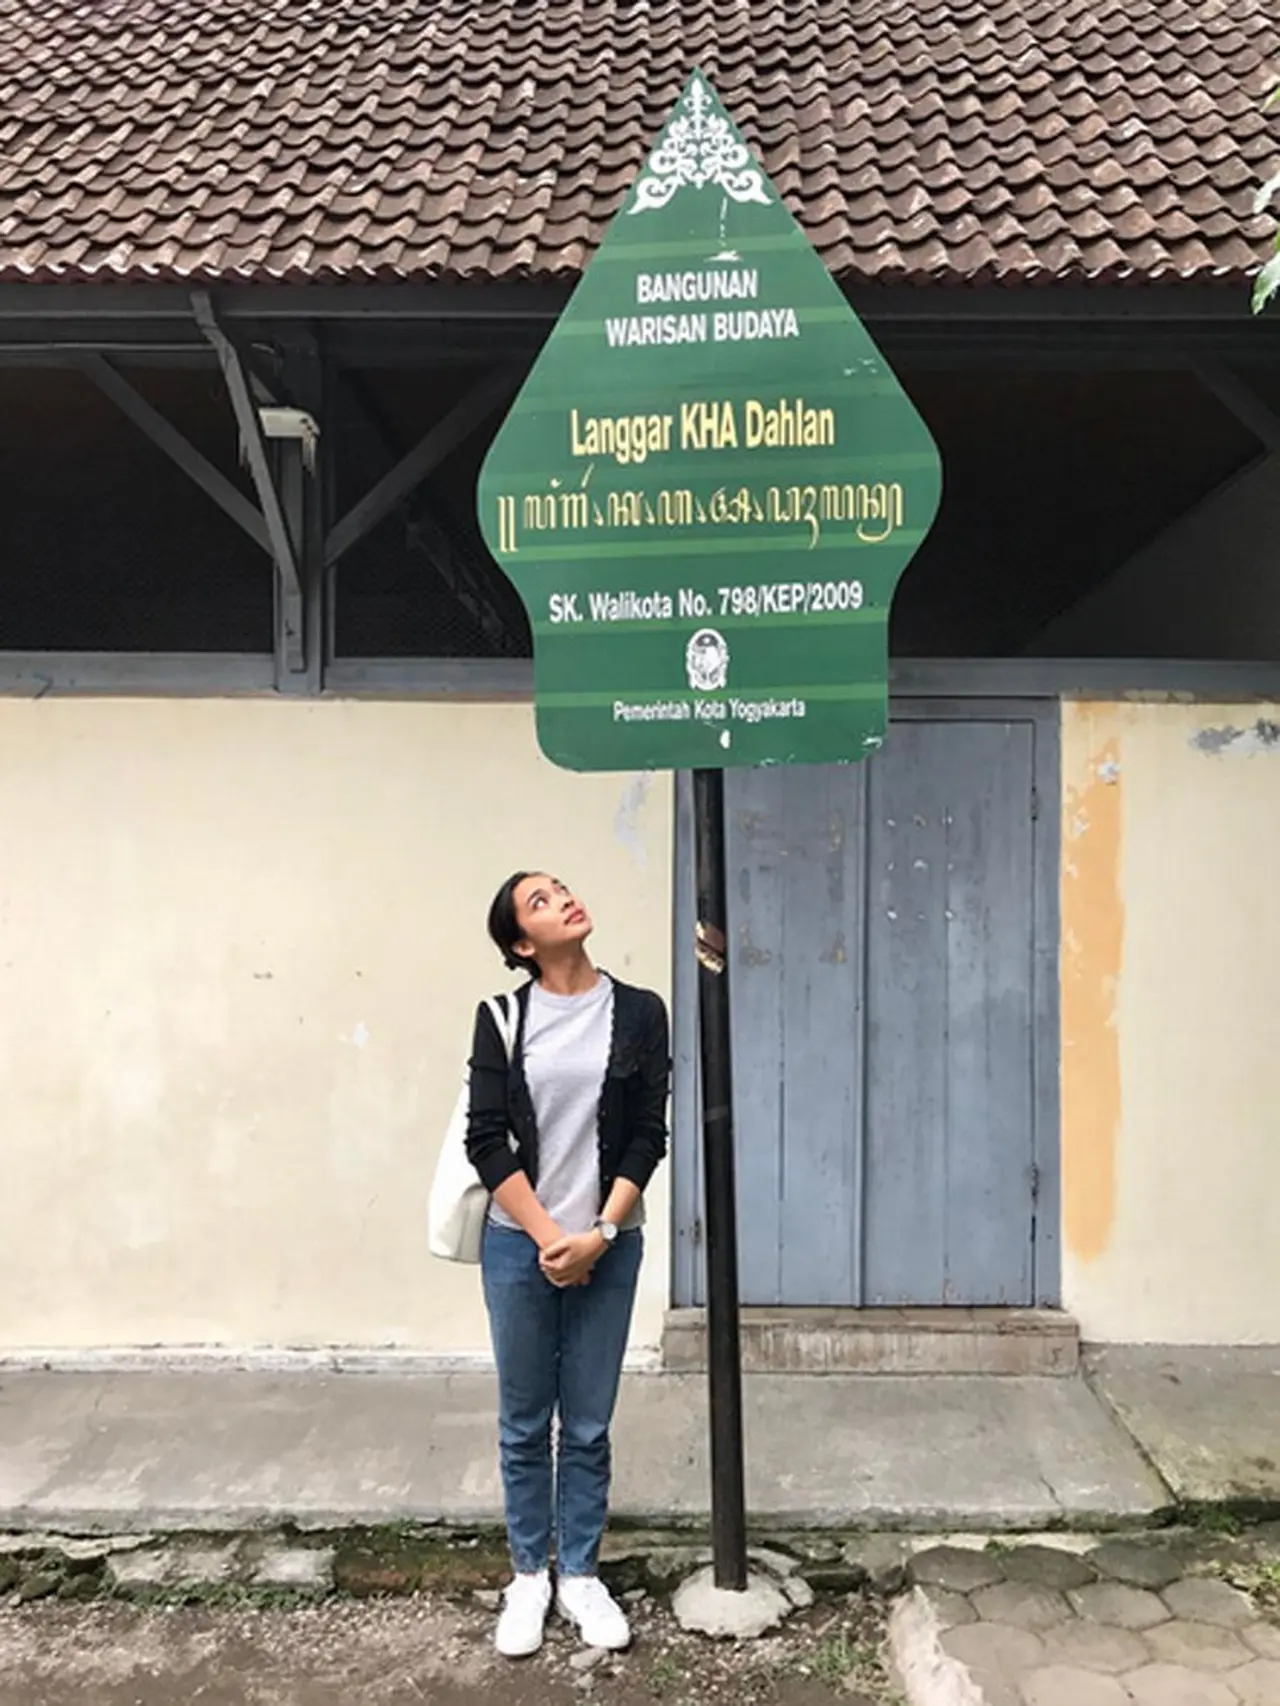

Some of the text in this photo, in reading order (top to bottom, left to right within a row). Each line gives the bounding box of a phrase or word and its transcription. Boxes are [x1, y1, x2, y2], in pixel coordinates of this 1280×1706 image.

[637, 269, 757, 304] BANGUNAN
[605, 308, 799, 347] WARISAN BUDAYA
[571, 399, 834, 463] Langgar KHA Dahlan
[549, 580, 863, 623] SK. Walikota No. 798/KEP/2009
[613, 698, 805, 722] Pemerintah Kota Yogyakarta
